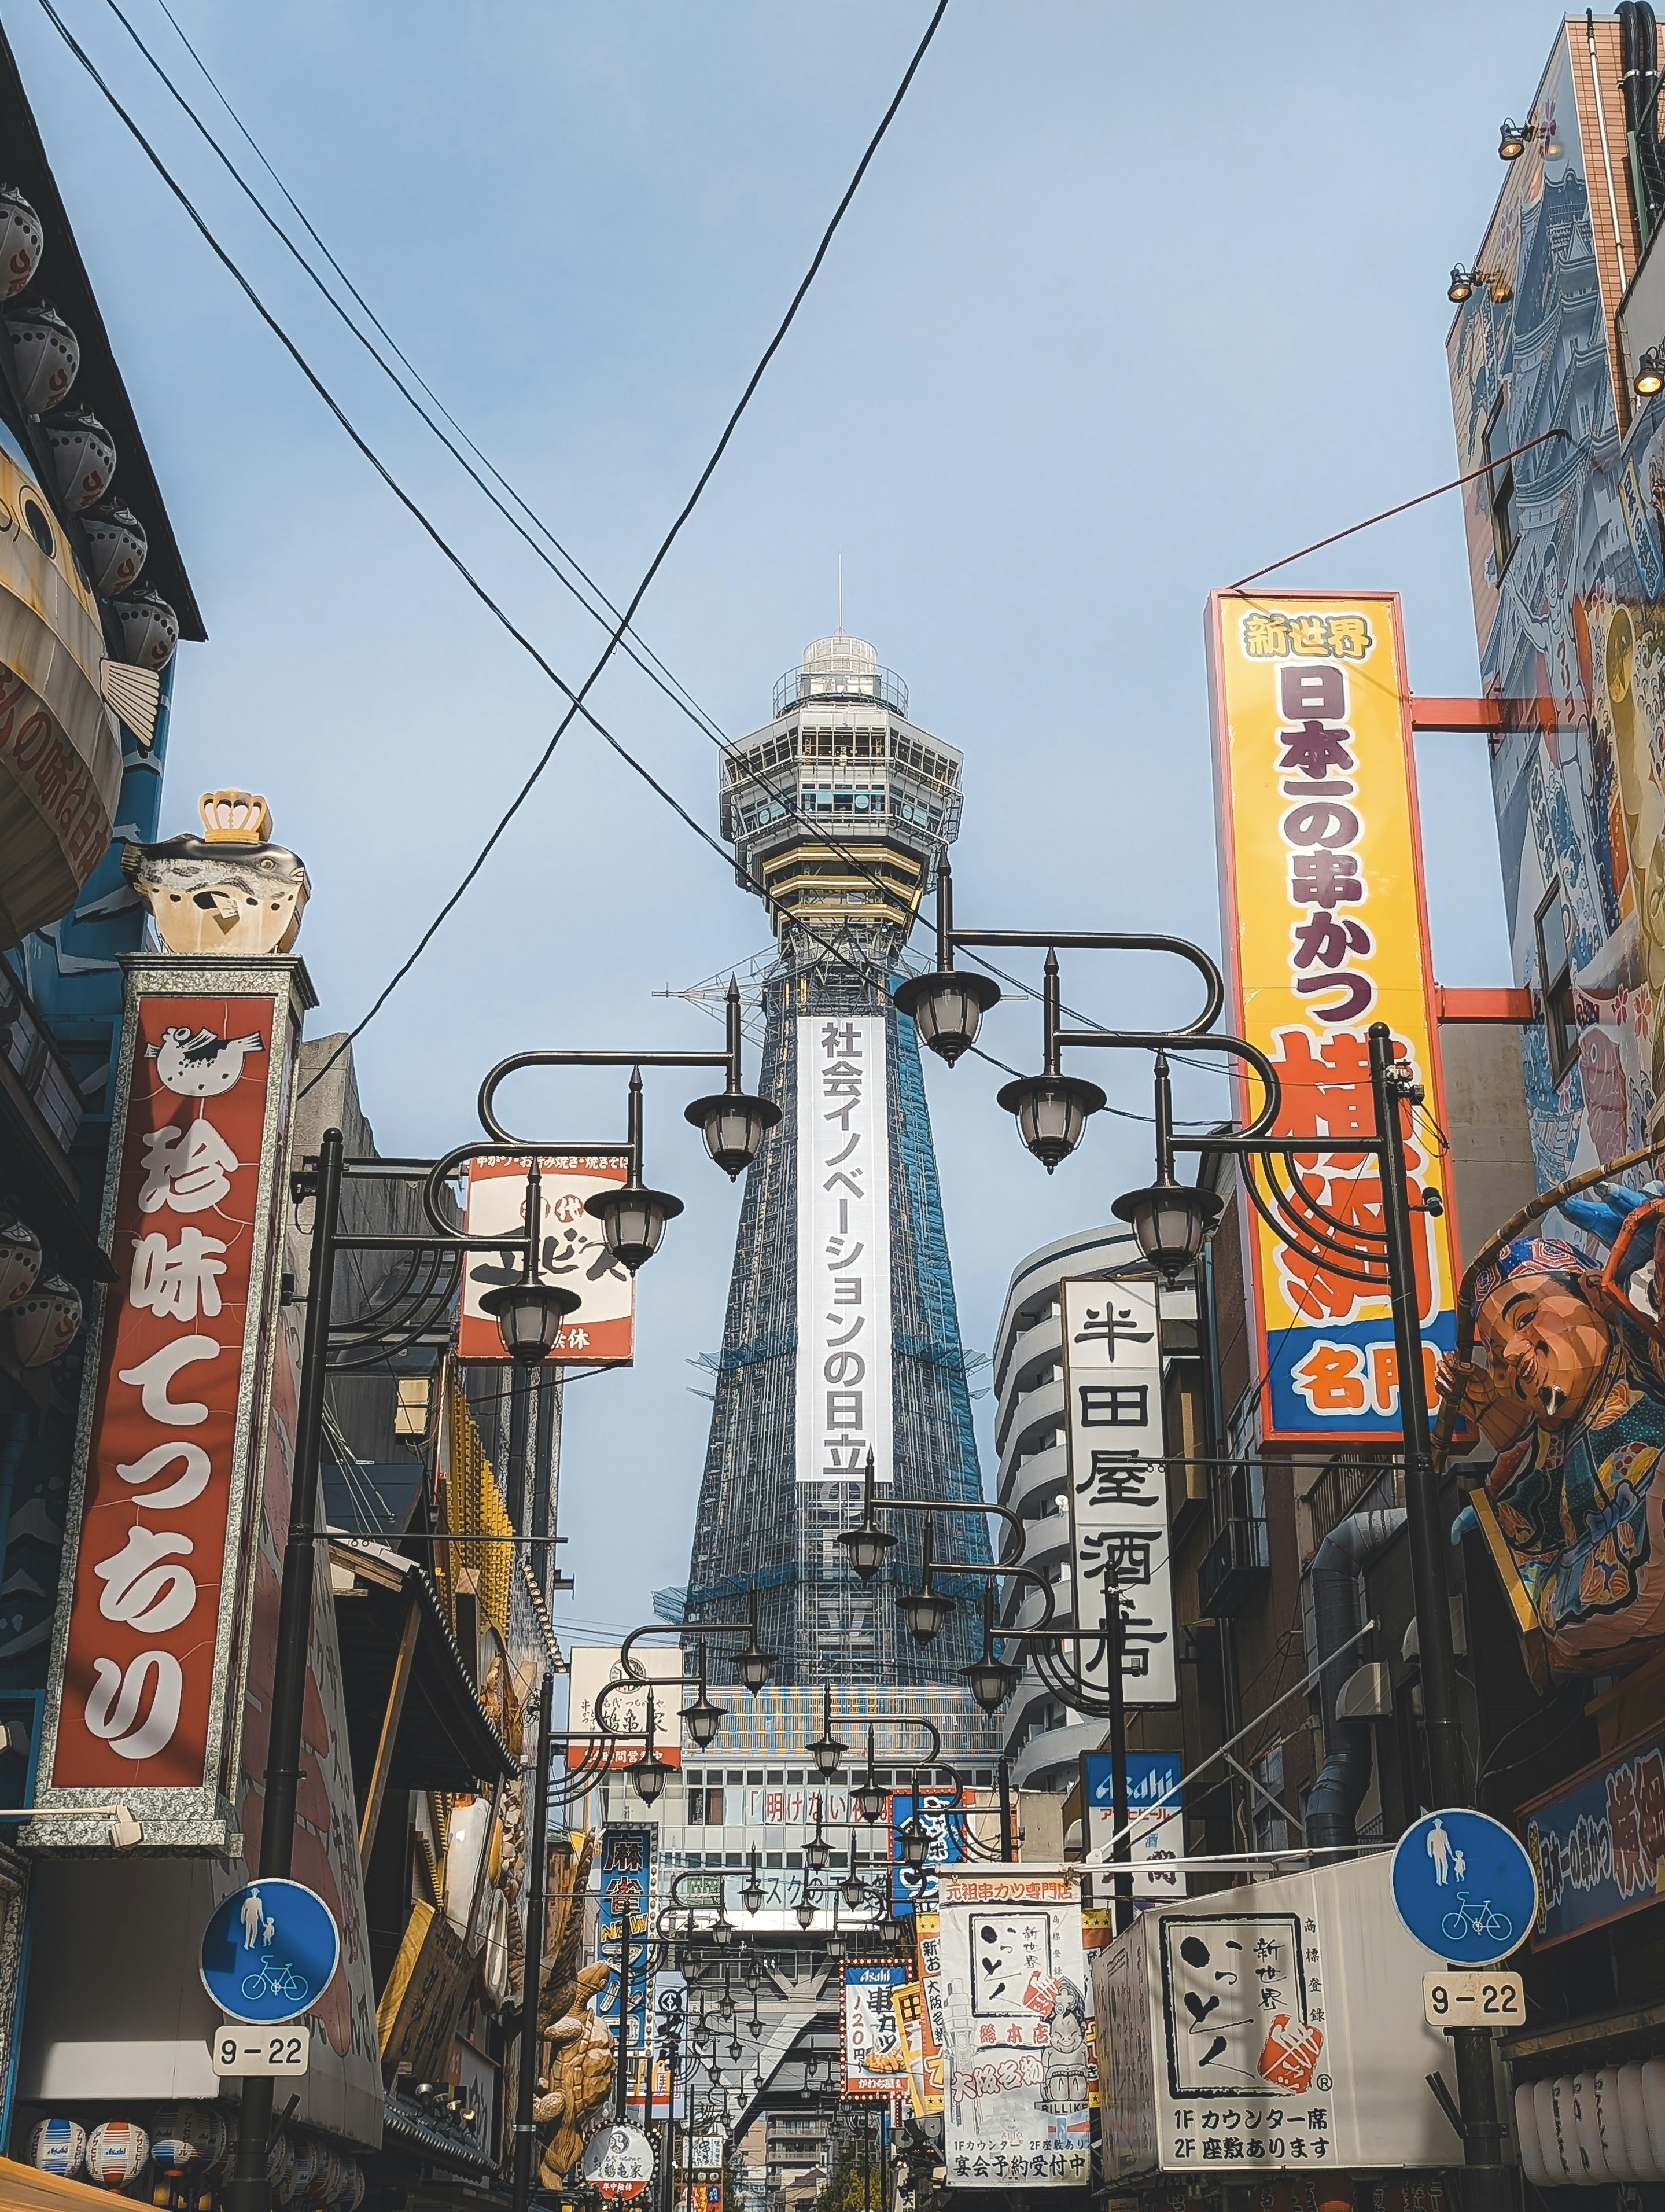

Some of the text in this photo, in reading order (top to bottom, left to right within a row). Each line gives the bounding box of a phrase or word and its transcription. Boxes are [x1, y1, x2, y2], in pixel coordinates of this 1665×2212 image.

[1245, 614, 1369, 657] 新世界
[1279, 665, 1372, 1022] 日本一の串かつ
[820, 1021, 867, 1476] 社会イノベーションの日立
[1074, 1301, 1169, 1677] 半田屋酒店
[1100, 1808, 1170, 1821] アヒビール
[603, 1834, 644, 1915] 麻雀
[946, 1882, 1074, 1901] 元祖串カツ専門店
[860, 1969, 891, 1983] Asahi
[1252, 1937, 1288, 2011] 新世界
[1303, 1917, 1325, 2022] 商標登録
[867, 1986, 897, 2053] 串カツ
[1431, 1985, 1519, 2015] 9-22
[221, 2038, 301, 2064] 9-22
[952, 2055, 1046, 2103] 大阪名物
[1174, 2108, 1328, 2130] 1F カウンター席
[954, 2154, 1086, 2178] 宴会予約受付中
[1174, 2137, 1330, 2160] 2F 座敷あります
